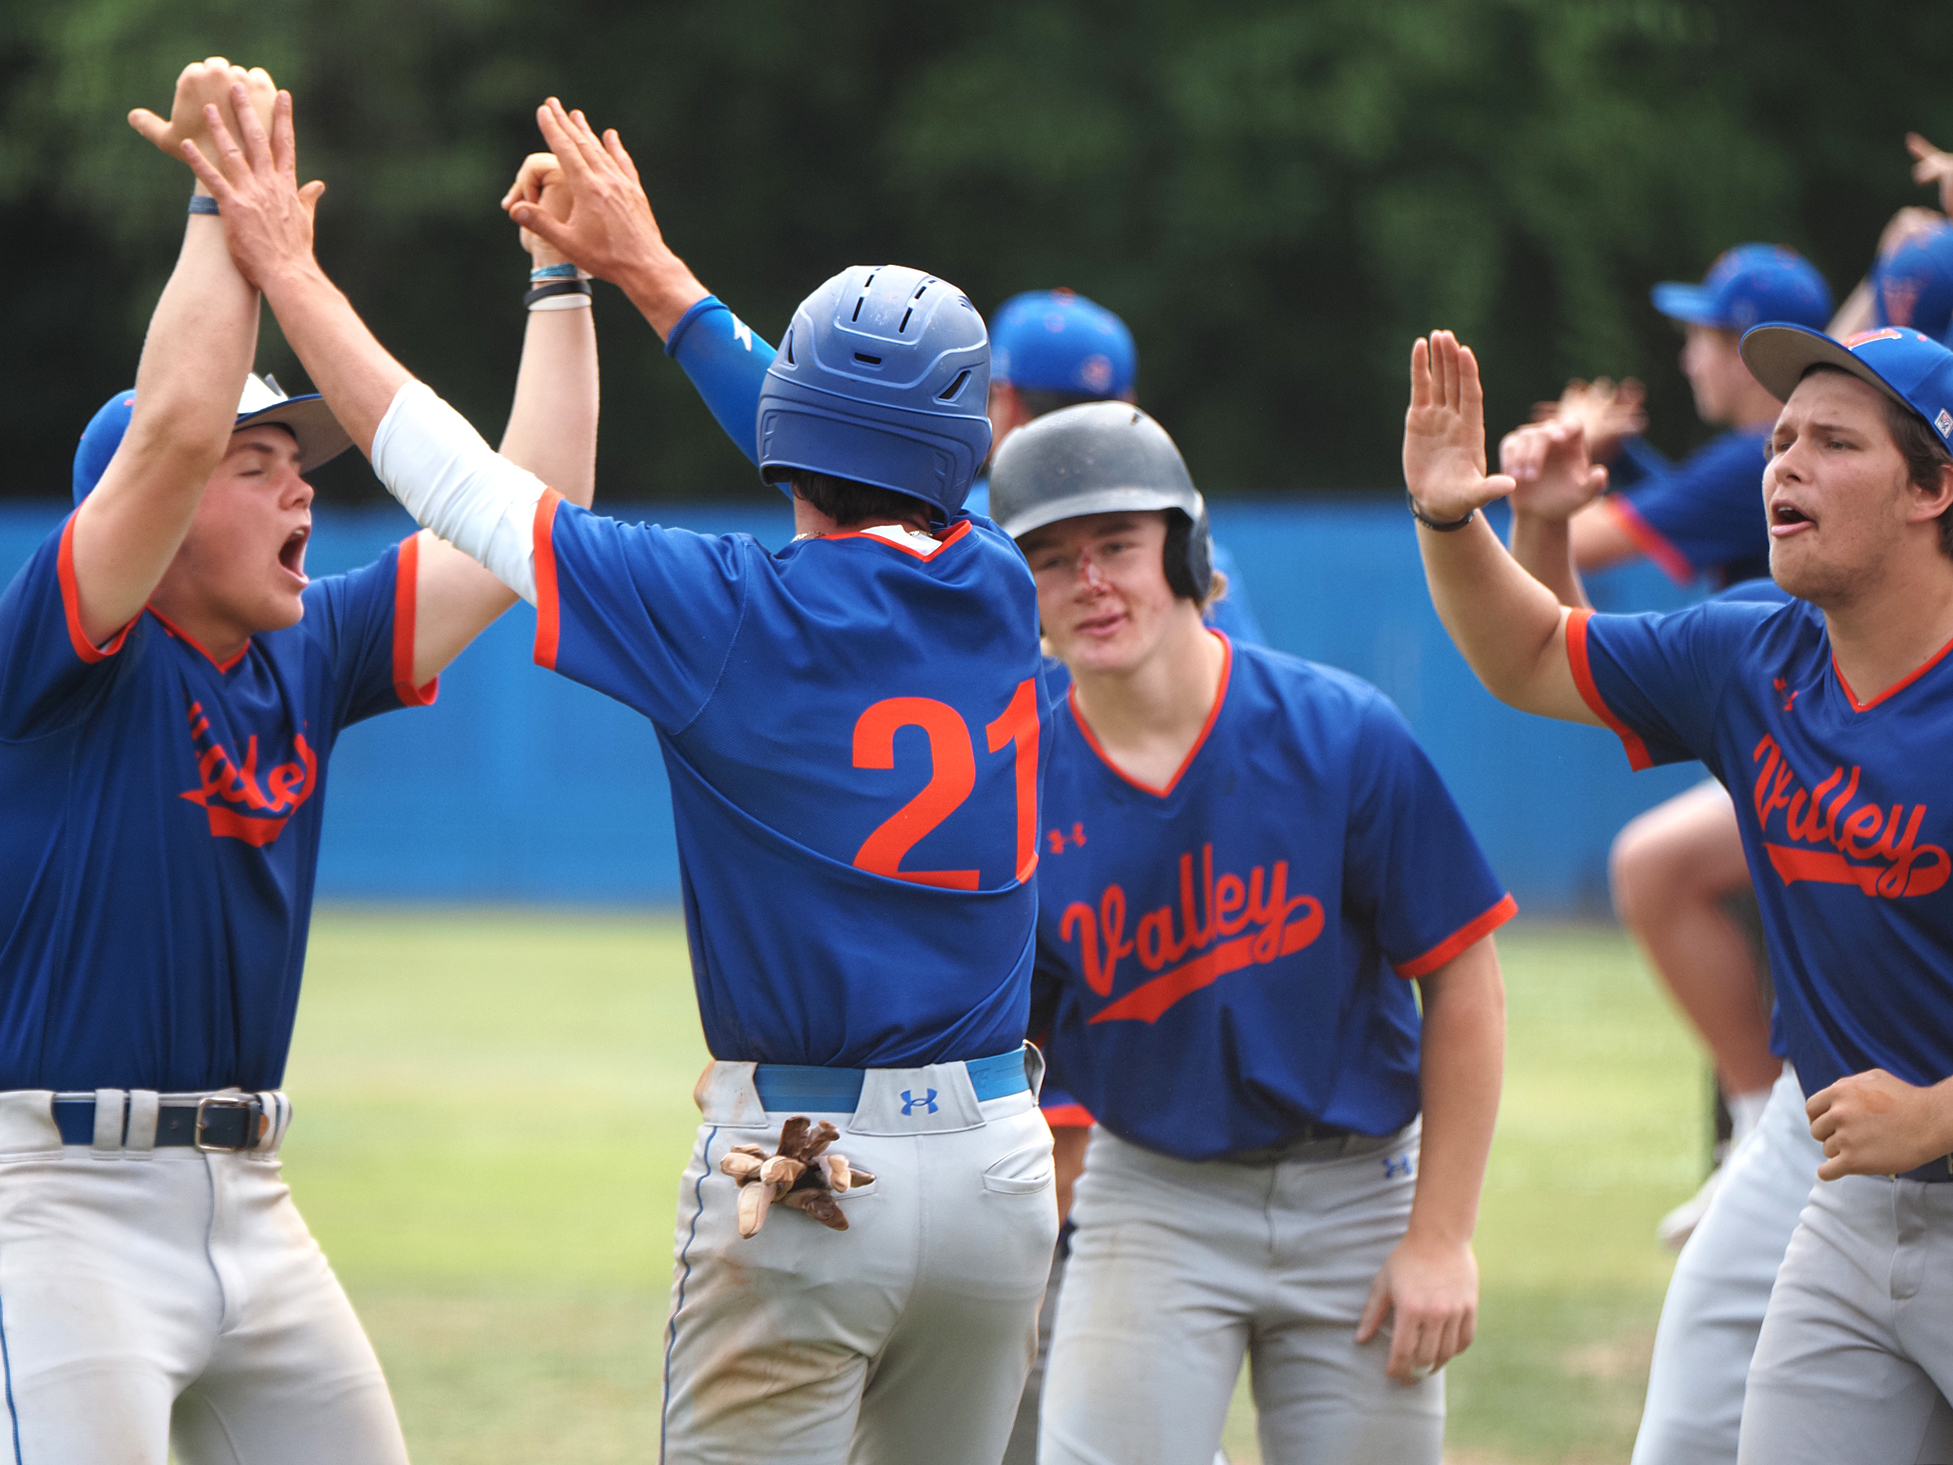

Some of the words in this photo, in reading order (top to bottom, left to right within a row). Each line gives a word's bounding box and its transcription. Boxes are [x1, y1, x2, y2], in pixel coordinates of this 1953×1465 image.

[852, 677, 1041, 891] 21
[1753, 733, 1952, 899] Valley
[1059, 842, 1326, 998] Valley
